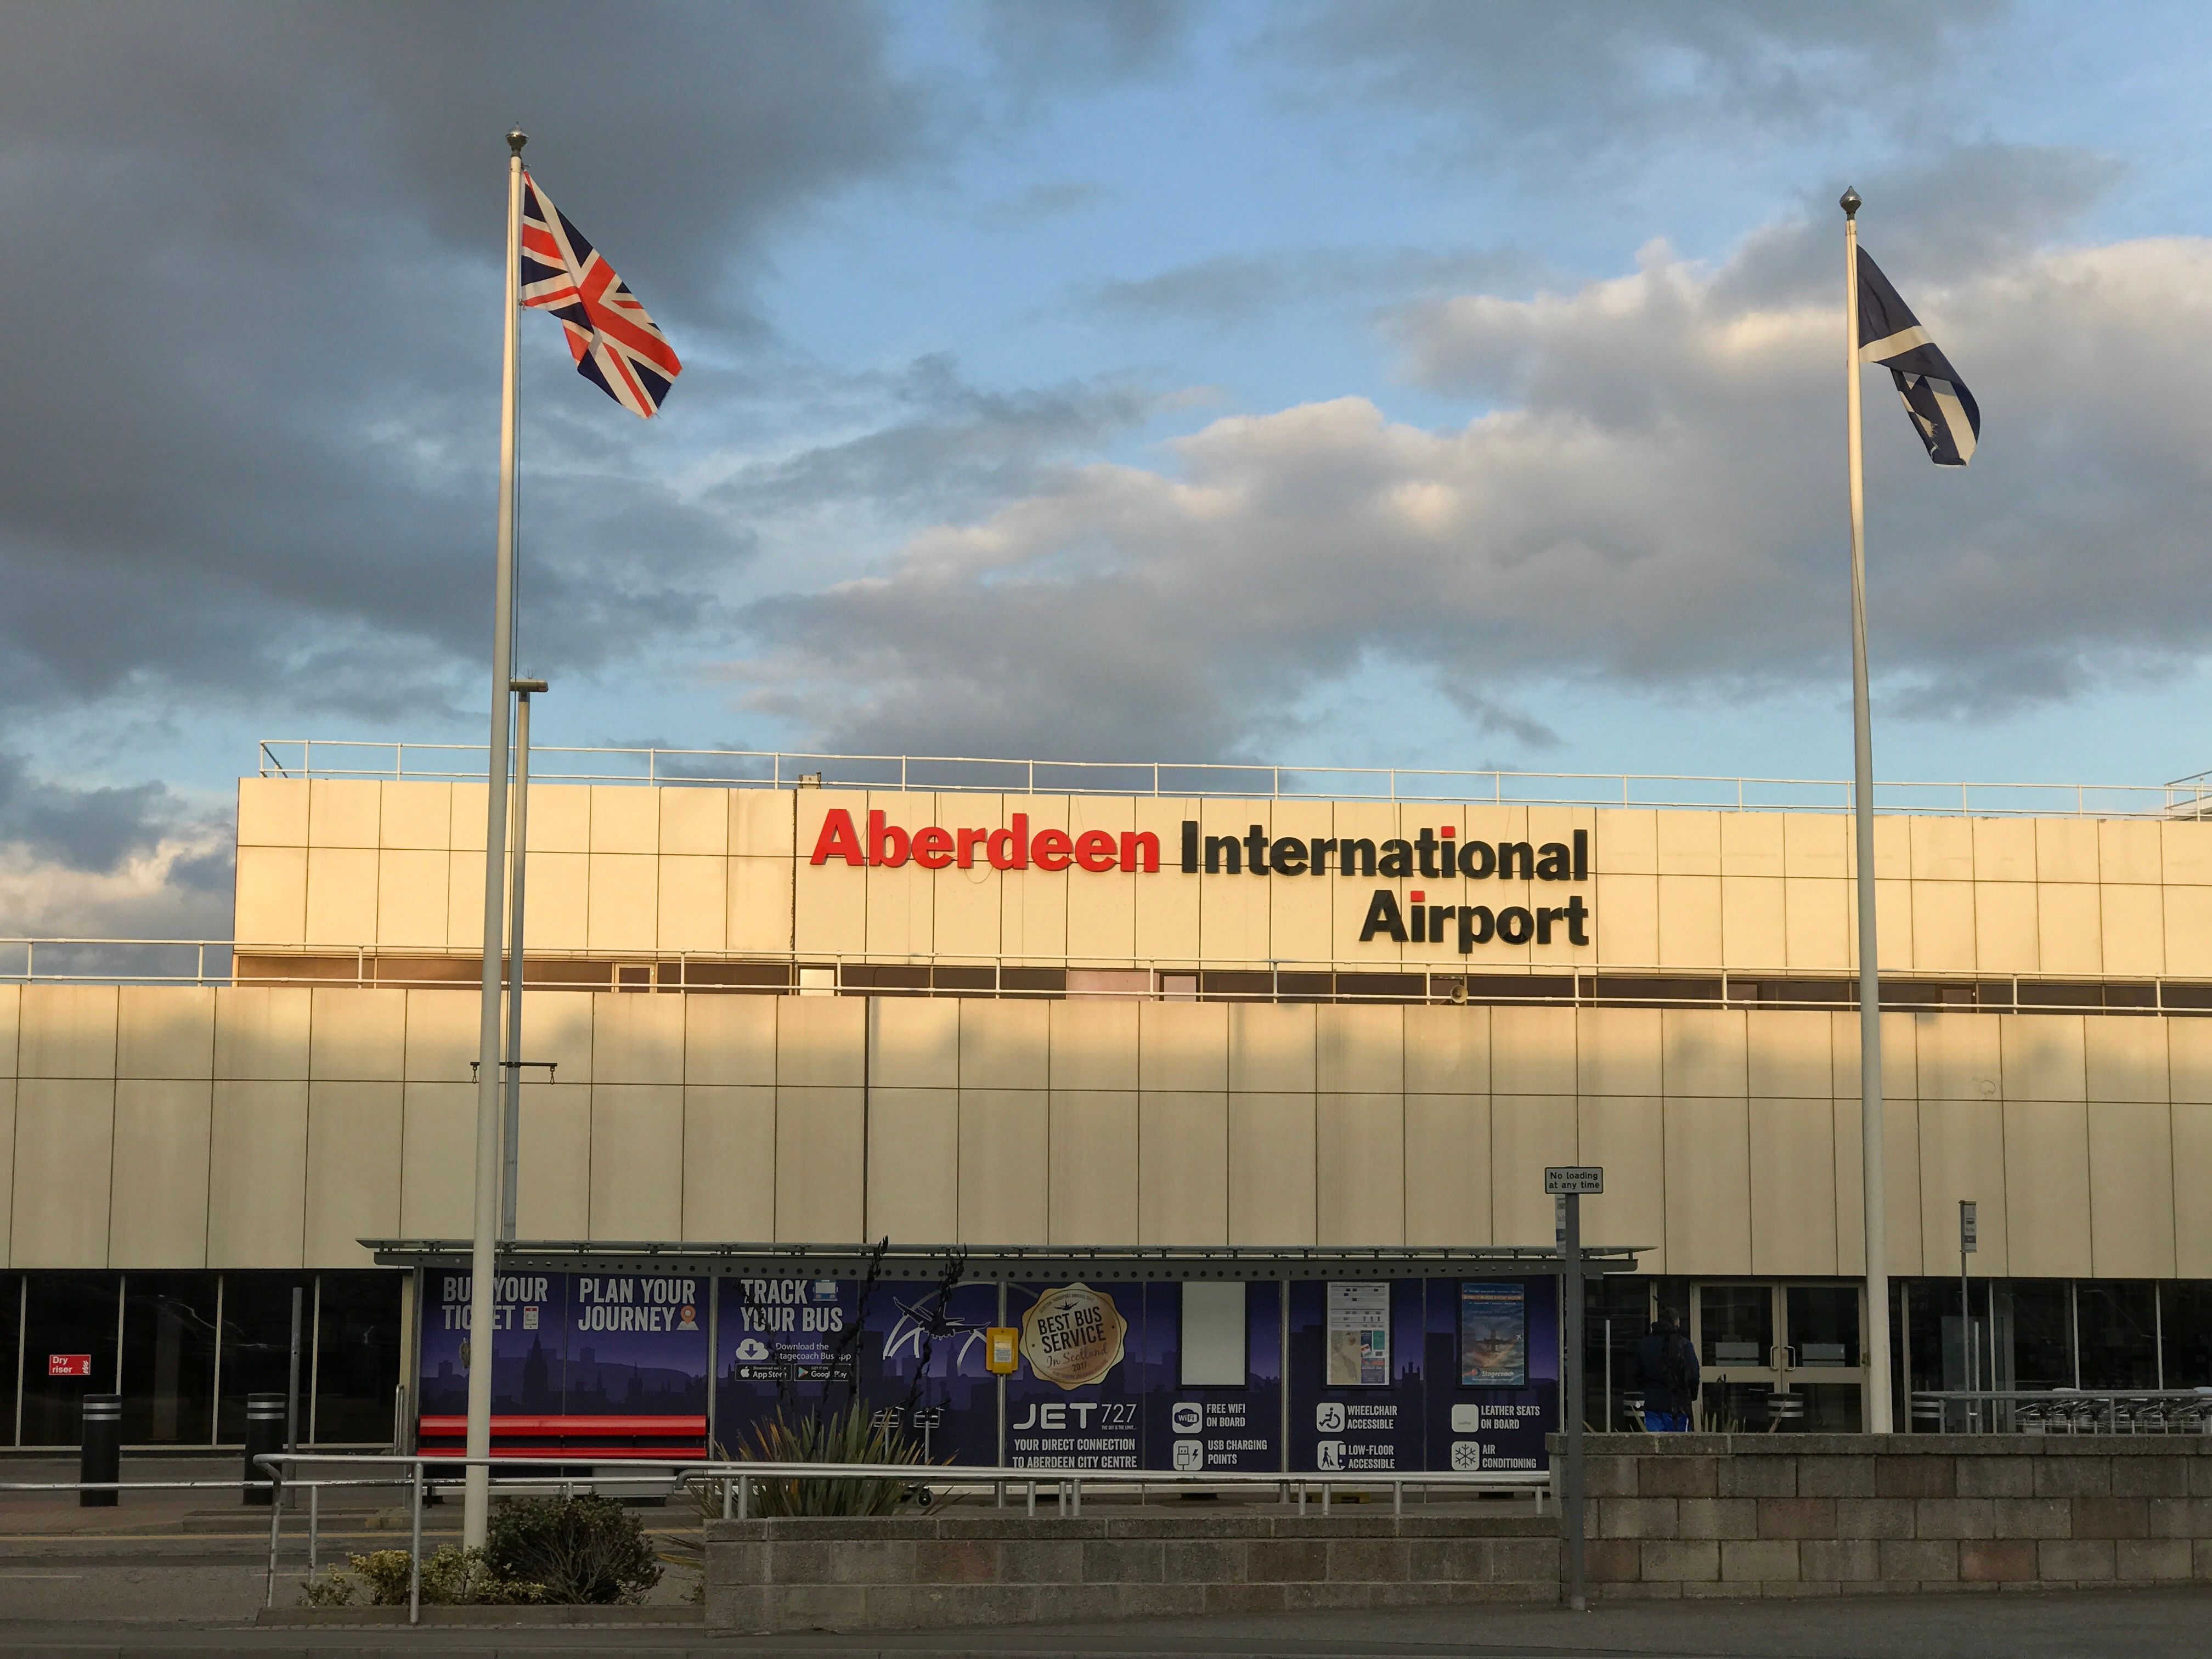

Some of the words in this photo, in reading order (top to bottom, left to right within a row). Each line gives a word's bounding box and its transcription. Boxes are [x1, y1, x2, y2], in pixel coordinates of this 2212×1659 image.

[809, 808, 1160, 872] Aberdeen
[1181, 820, 1588, 881] International
[1358, 889, 1590, 954] Airport
[1566, 1172, 1598, 1180] loading
[443, 1277, 471, 1302] BU
[493, 1277, 548, 1302] YOUR
[579, 1278, 633, 1303] PLAN
[641, 1278, 696, 1304] YOUR
[741, 1279, 808, 1304] TRACK
[442, 1305, 516, 1330] TICET
[578, 1306, 676, 1331] JOURNEY
[741, 1307, 795, 1332] YOUR
[802, 1307, 843, 1332] BUS
[1037, 1313, 1070, 1335] BEST
[1074, 1306, 1102, 1327] BUS
[1041, 1323, 1107, 1353] SERVICE
[53, 1356, 68, 1365] Dry
[776, 1352, 819, 1361] tagecoach
[1046, 1356, 1061, 1368] In
[1063, 1344, 1108, 1364] Scotland
[1072, 1362, 1087, 1372] 2017
[753, 1370, 768, 1379] App
[811, 1370, 831, 1379] Googl
[1206, 1403, 1227, 1414] FREE
[1228, 1403, 1246, 1414] WIFI
[1347, 1405, 1398, 1415] WHEELCHAIR
[1481, 1405, 1515, 1415] LEATHER
[1516, 1406, 1541, 1416] SEATS
[1013, 1403, 1097, 1430] JET
[1102, 1404, 1137, 1423] 727
[1206, 1417, 1217, 1427] ON
[1220, 1417, 1246, 1427] BOARD
[1347, 1419, 1395, 1429] ACCESSIBLE
[1481, 1419, 1492, 1429] ON
[1494, 1419, 1520, 1429] BOARD
[1014, 1438, 1040, 1451] YOUR
[1042, 1438, 1075, 1451] DIRECT
[1077, 1438, 1136, 1451] CONNECTION
[1207, 1440, 1224, 1451] USB
[1226, 1440, 1268, 1451] CHARGING
[1348, 1444, 1394, 1455] LOW-FLOOR
[1482, 1444, 1496, 1454] AIR
[1012, 1456, 1025, 1468] TO
[1026, 1456, 1075, 1468] ABERDEEN
[1077, 1456, 1099, 1468] CITY
[1101, 1455, 1137, 1468] CENTRE
[1207, 1454, 1238, 1465] POINTS
[1348, 1458, 1396, 1469] ACCESSIBLE
[1482, 1458, 1537, 1469] CONDITIONING
